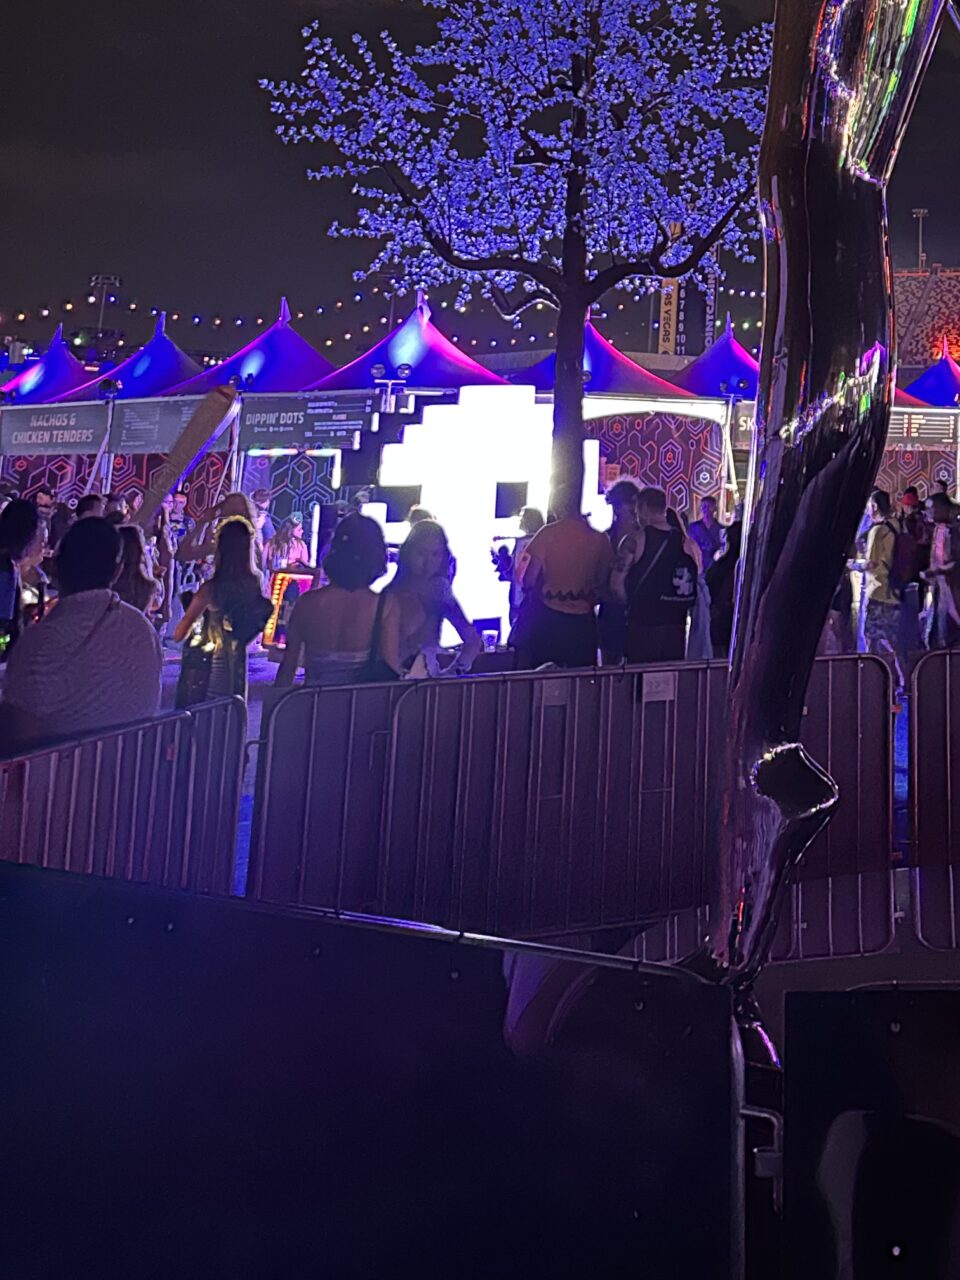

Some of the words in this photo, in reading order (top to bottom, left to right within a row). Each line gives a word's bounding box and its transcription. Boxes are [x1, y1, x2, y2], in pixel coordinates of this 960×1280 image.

[679, 289, 686, 298] 6
[679, 301, 686, 309] 7
[678, 311, 685, 320] 8
[662, 308, 673, 343] VEGAS
[678, 323, 684, 332] 9
[676, 335, 686, 343] 10
[30, 413, 68, 427] NACHOS
[69, 413, 76, 426] &
[245, 412, 279, 425] DIPPIN'
[280, 412, 305, 424] DOTS
[12, 431, 50, 444] CHICKEN
[52, 429, 94, 443] TENDERS
